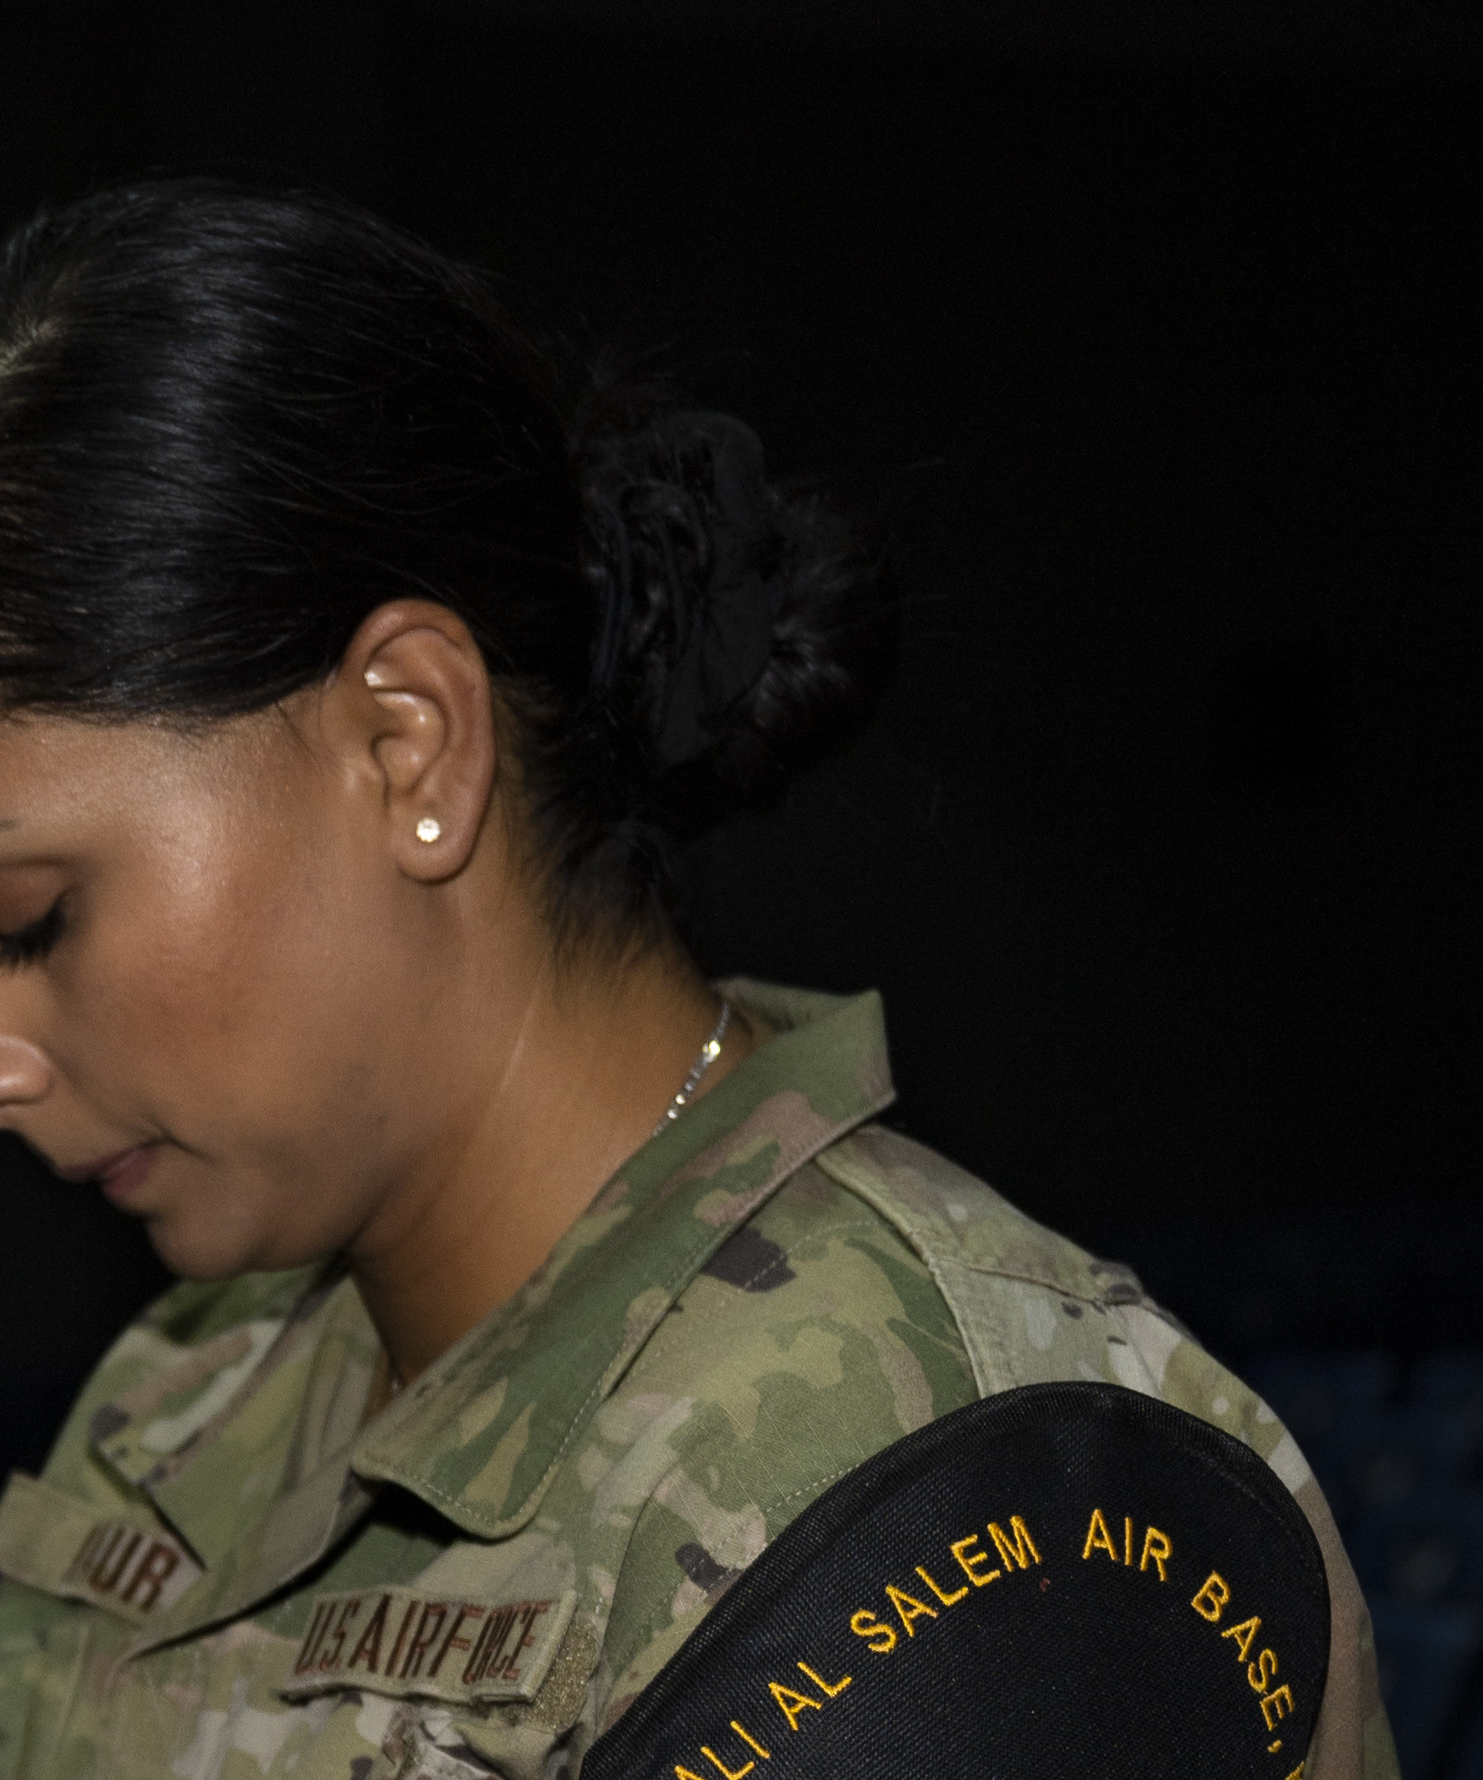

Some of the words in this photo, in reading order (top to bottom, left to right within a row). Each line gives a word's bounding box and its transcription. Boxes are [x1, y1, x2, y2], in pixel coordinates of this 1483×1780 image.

[347, 1592, 447, 1680] AIR
[767, 1661, 853, 1732] AL
[849, 1514, 1042, 1654] SALEM
[1080, 1507, 1174, 1583] AIR
[1190, 1569, 1294, 1753] BASE,
